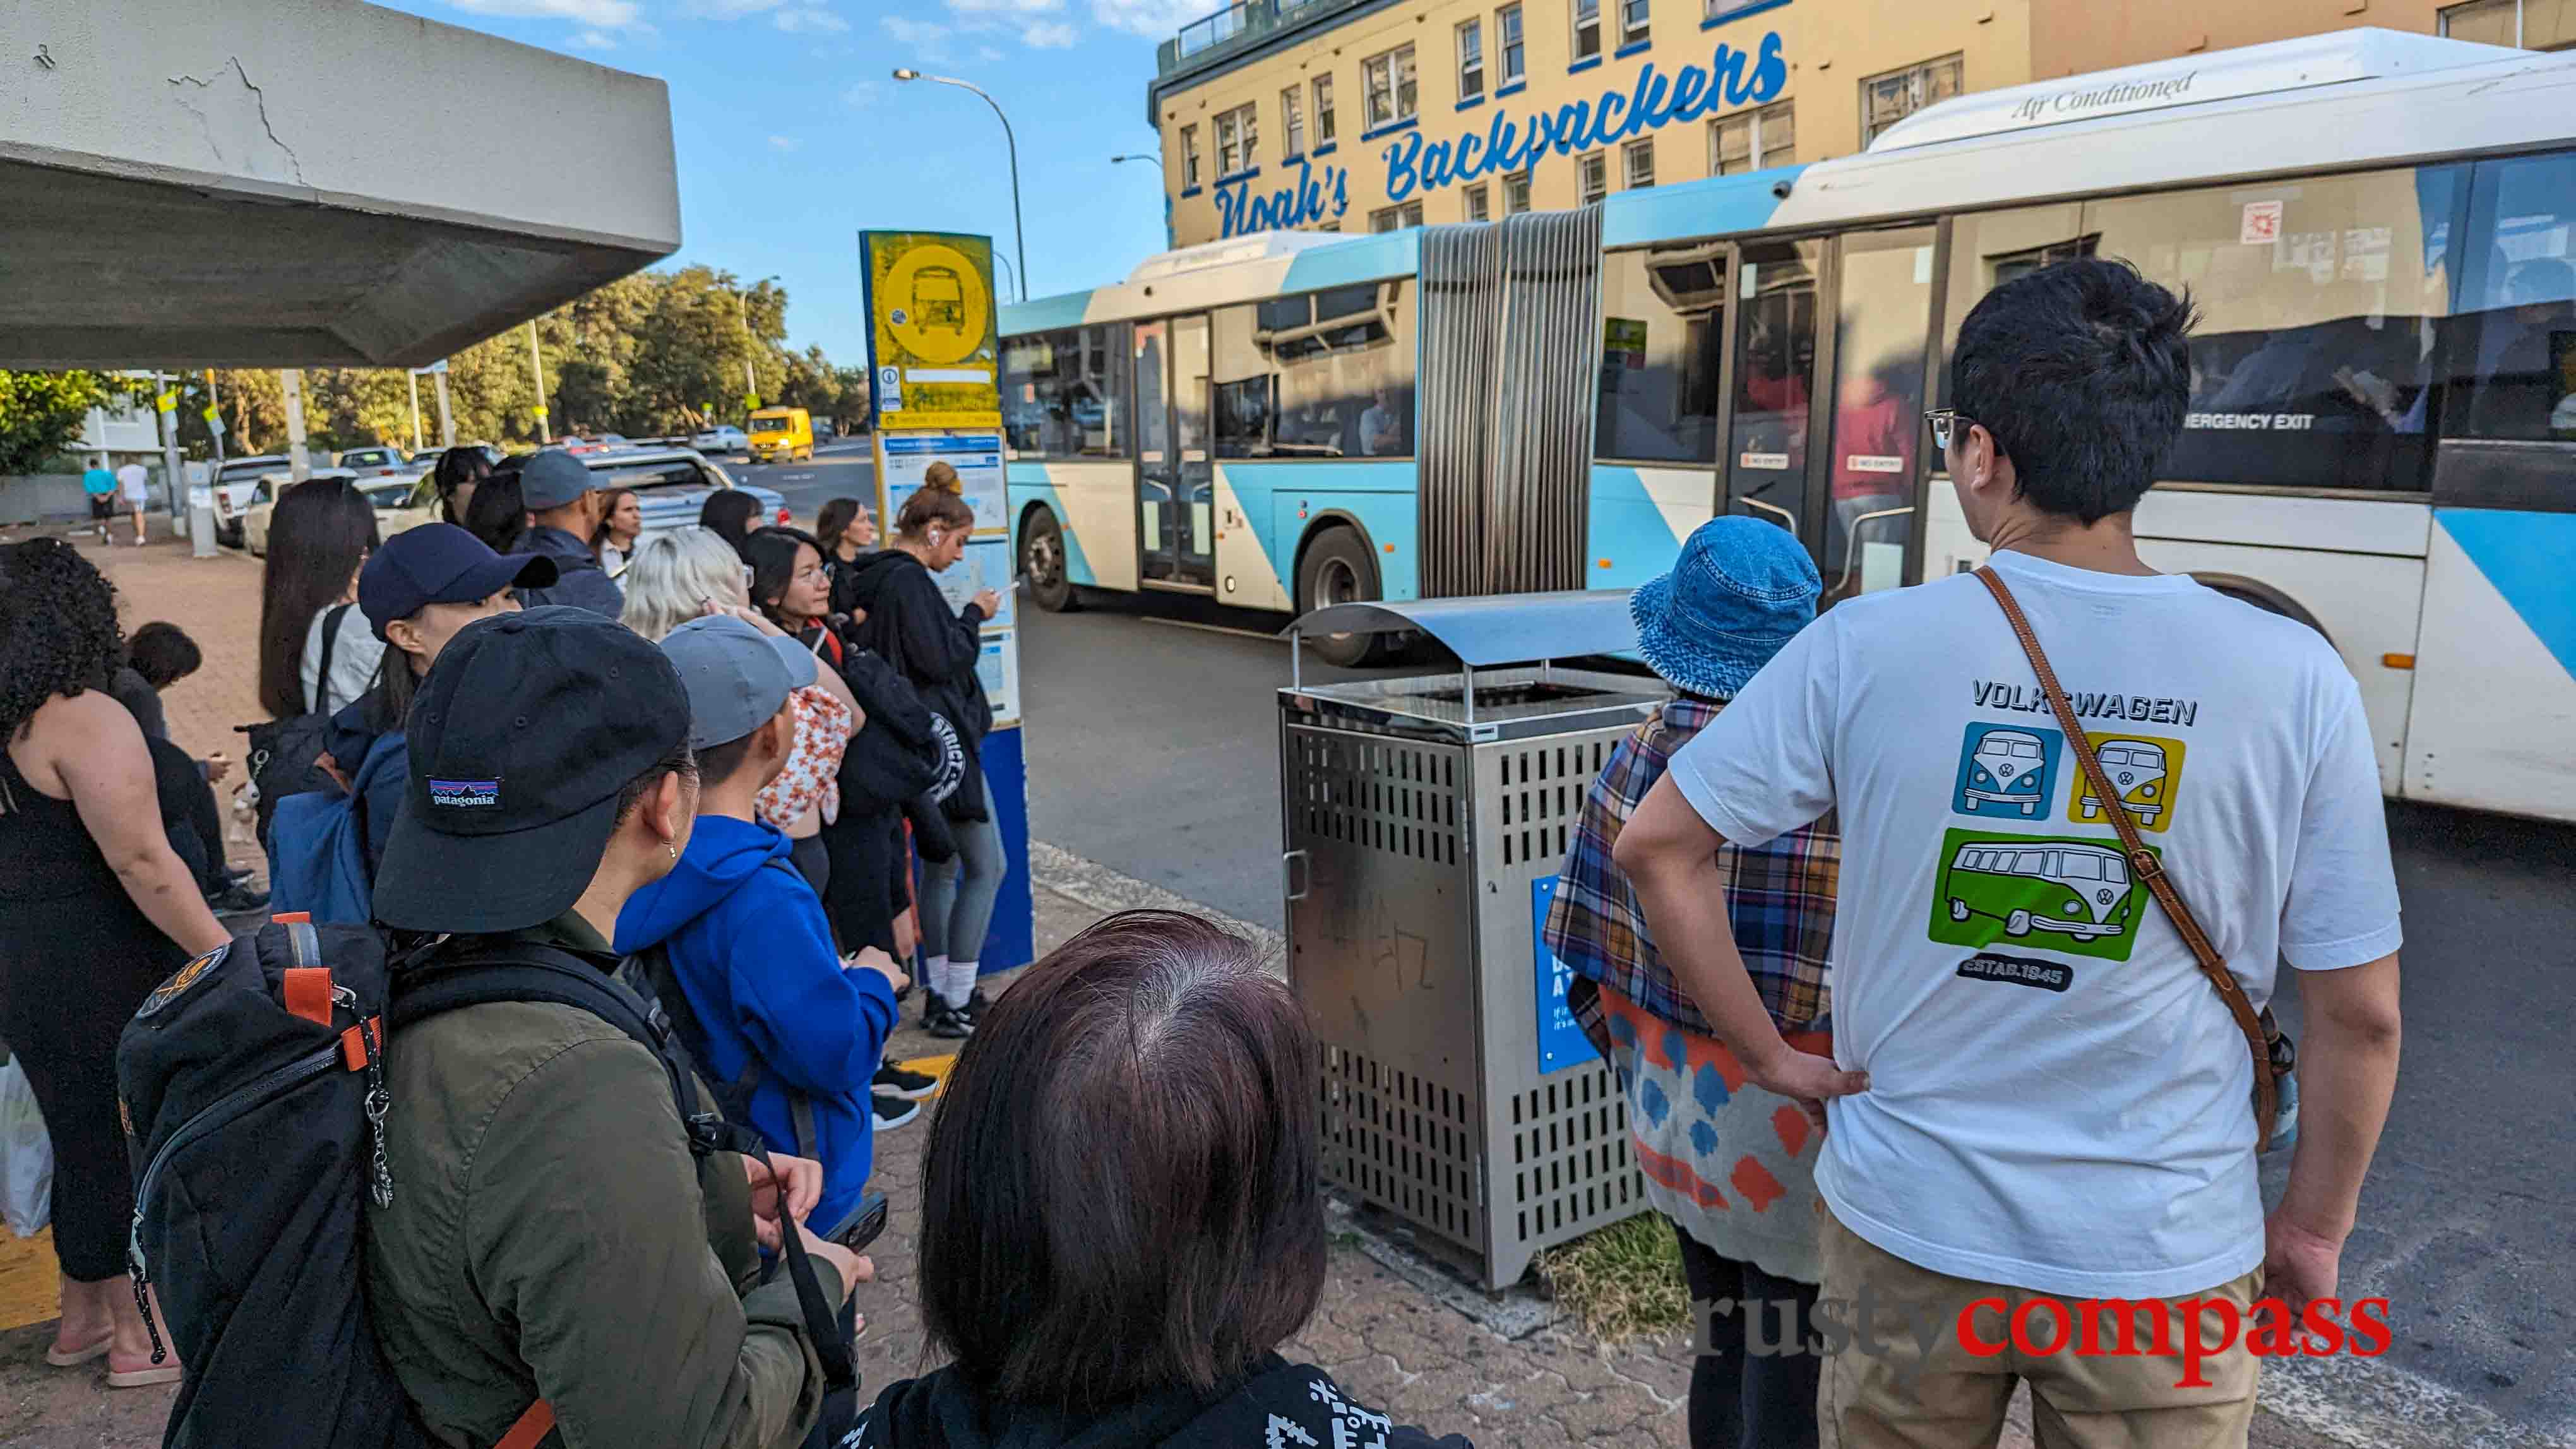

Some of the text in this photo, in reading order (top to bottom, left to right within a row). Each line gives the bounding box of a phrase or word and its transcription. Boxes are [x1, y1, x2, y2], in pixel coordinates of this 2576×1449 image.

[2011, 70, 2198, 121] Air Conditioned
[1213, 32, 1786, 239] Noah's Backpackers
[2274, 414, 2313, 429] EXIT
[434, 795, 496, 807] patagonia
